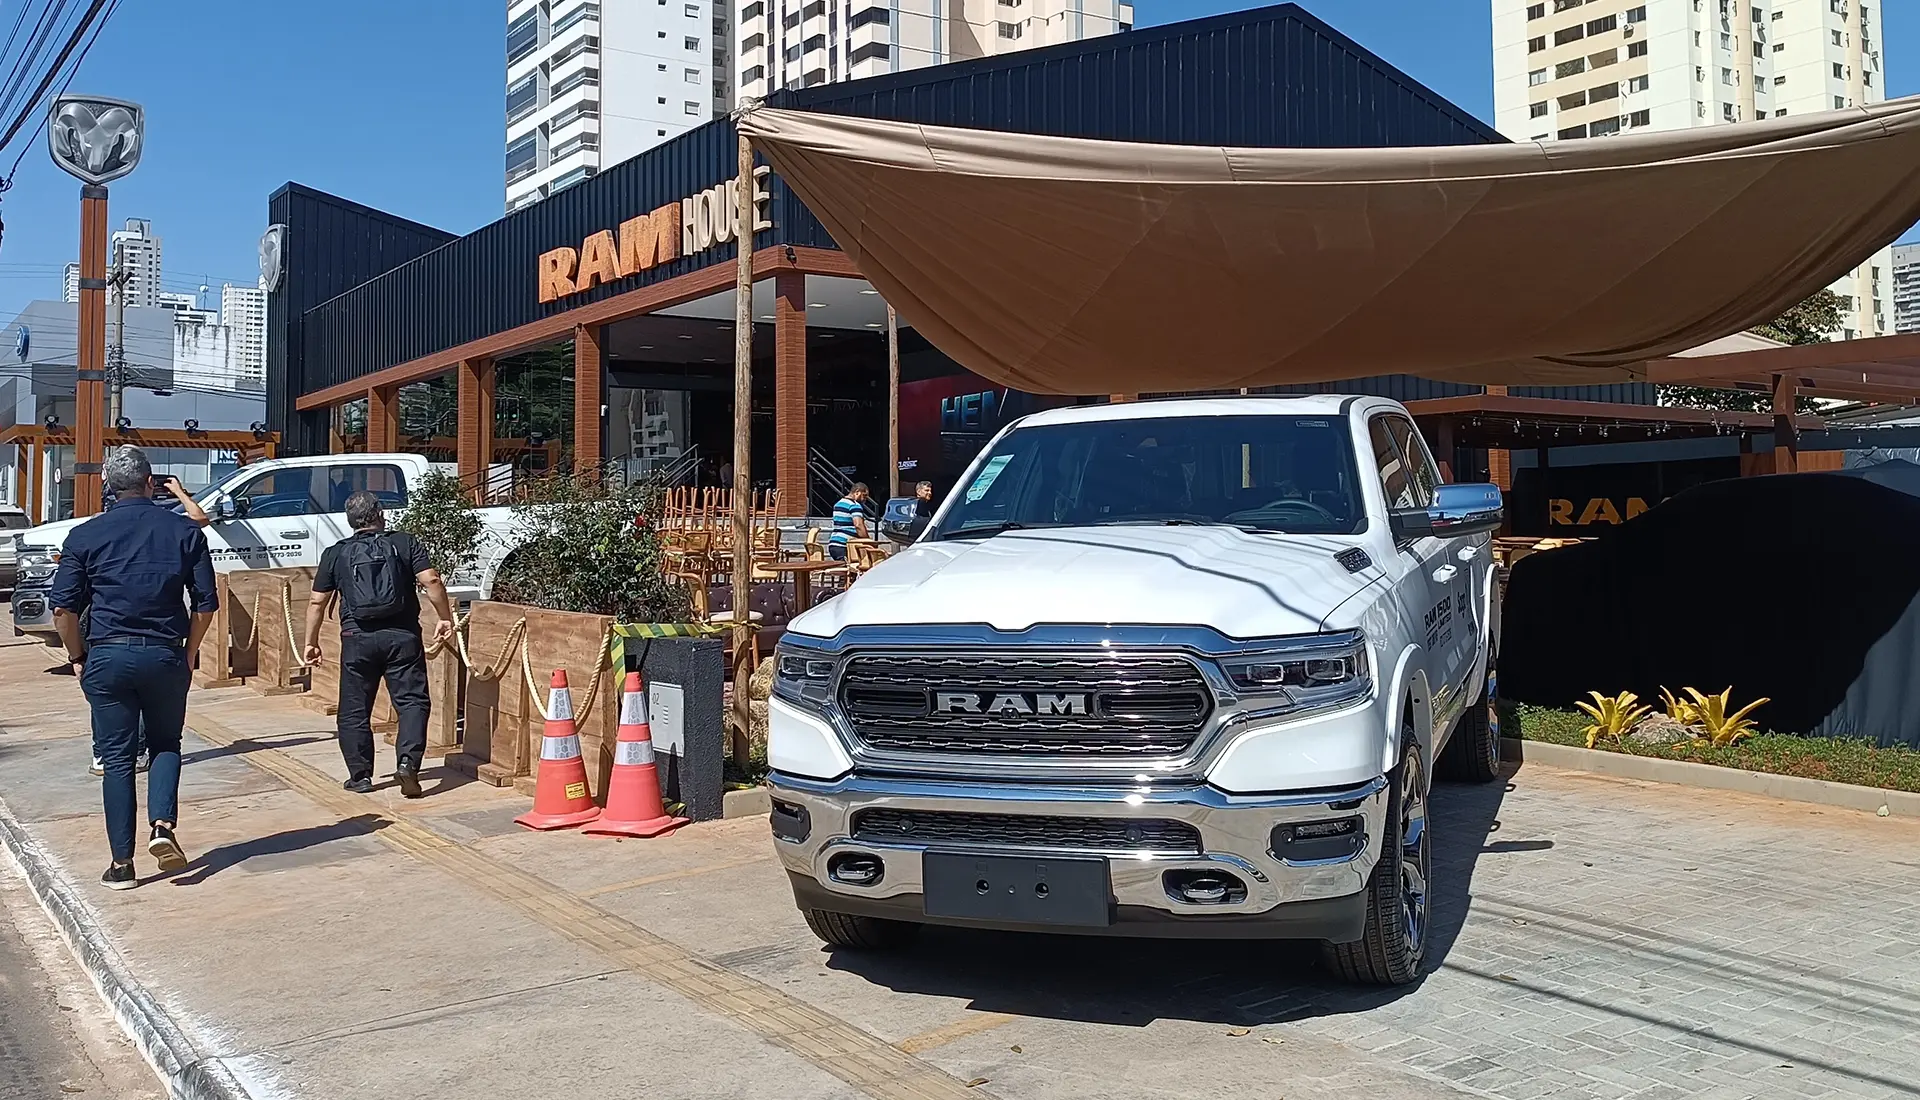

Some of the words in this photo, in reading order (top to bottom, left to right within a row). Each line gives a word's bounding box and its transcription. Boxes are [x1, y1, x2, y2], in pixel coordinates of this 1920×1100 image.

[539, 202, 680, 303] RAM
[1424, 605, 1437, 631] RAM
[937, 692, 1087, 715] RAM
